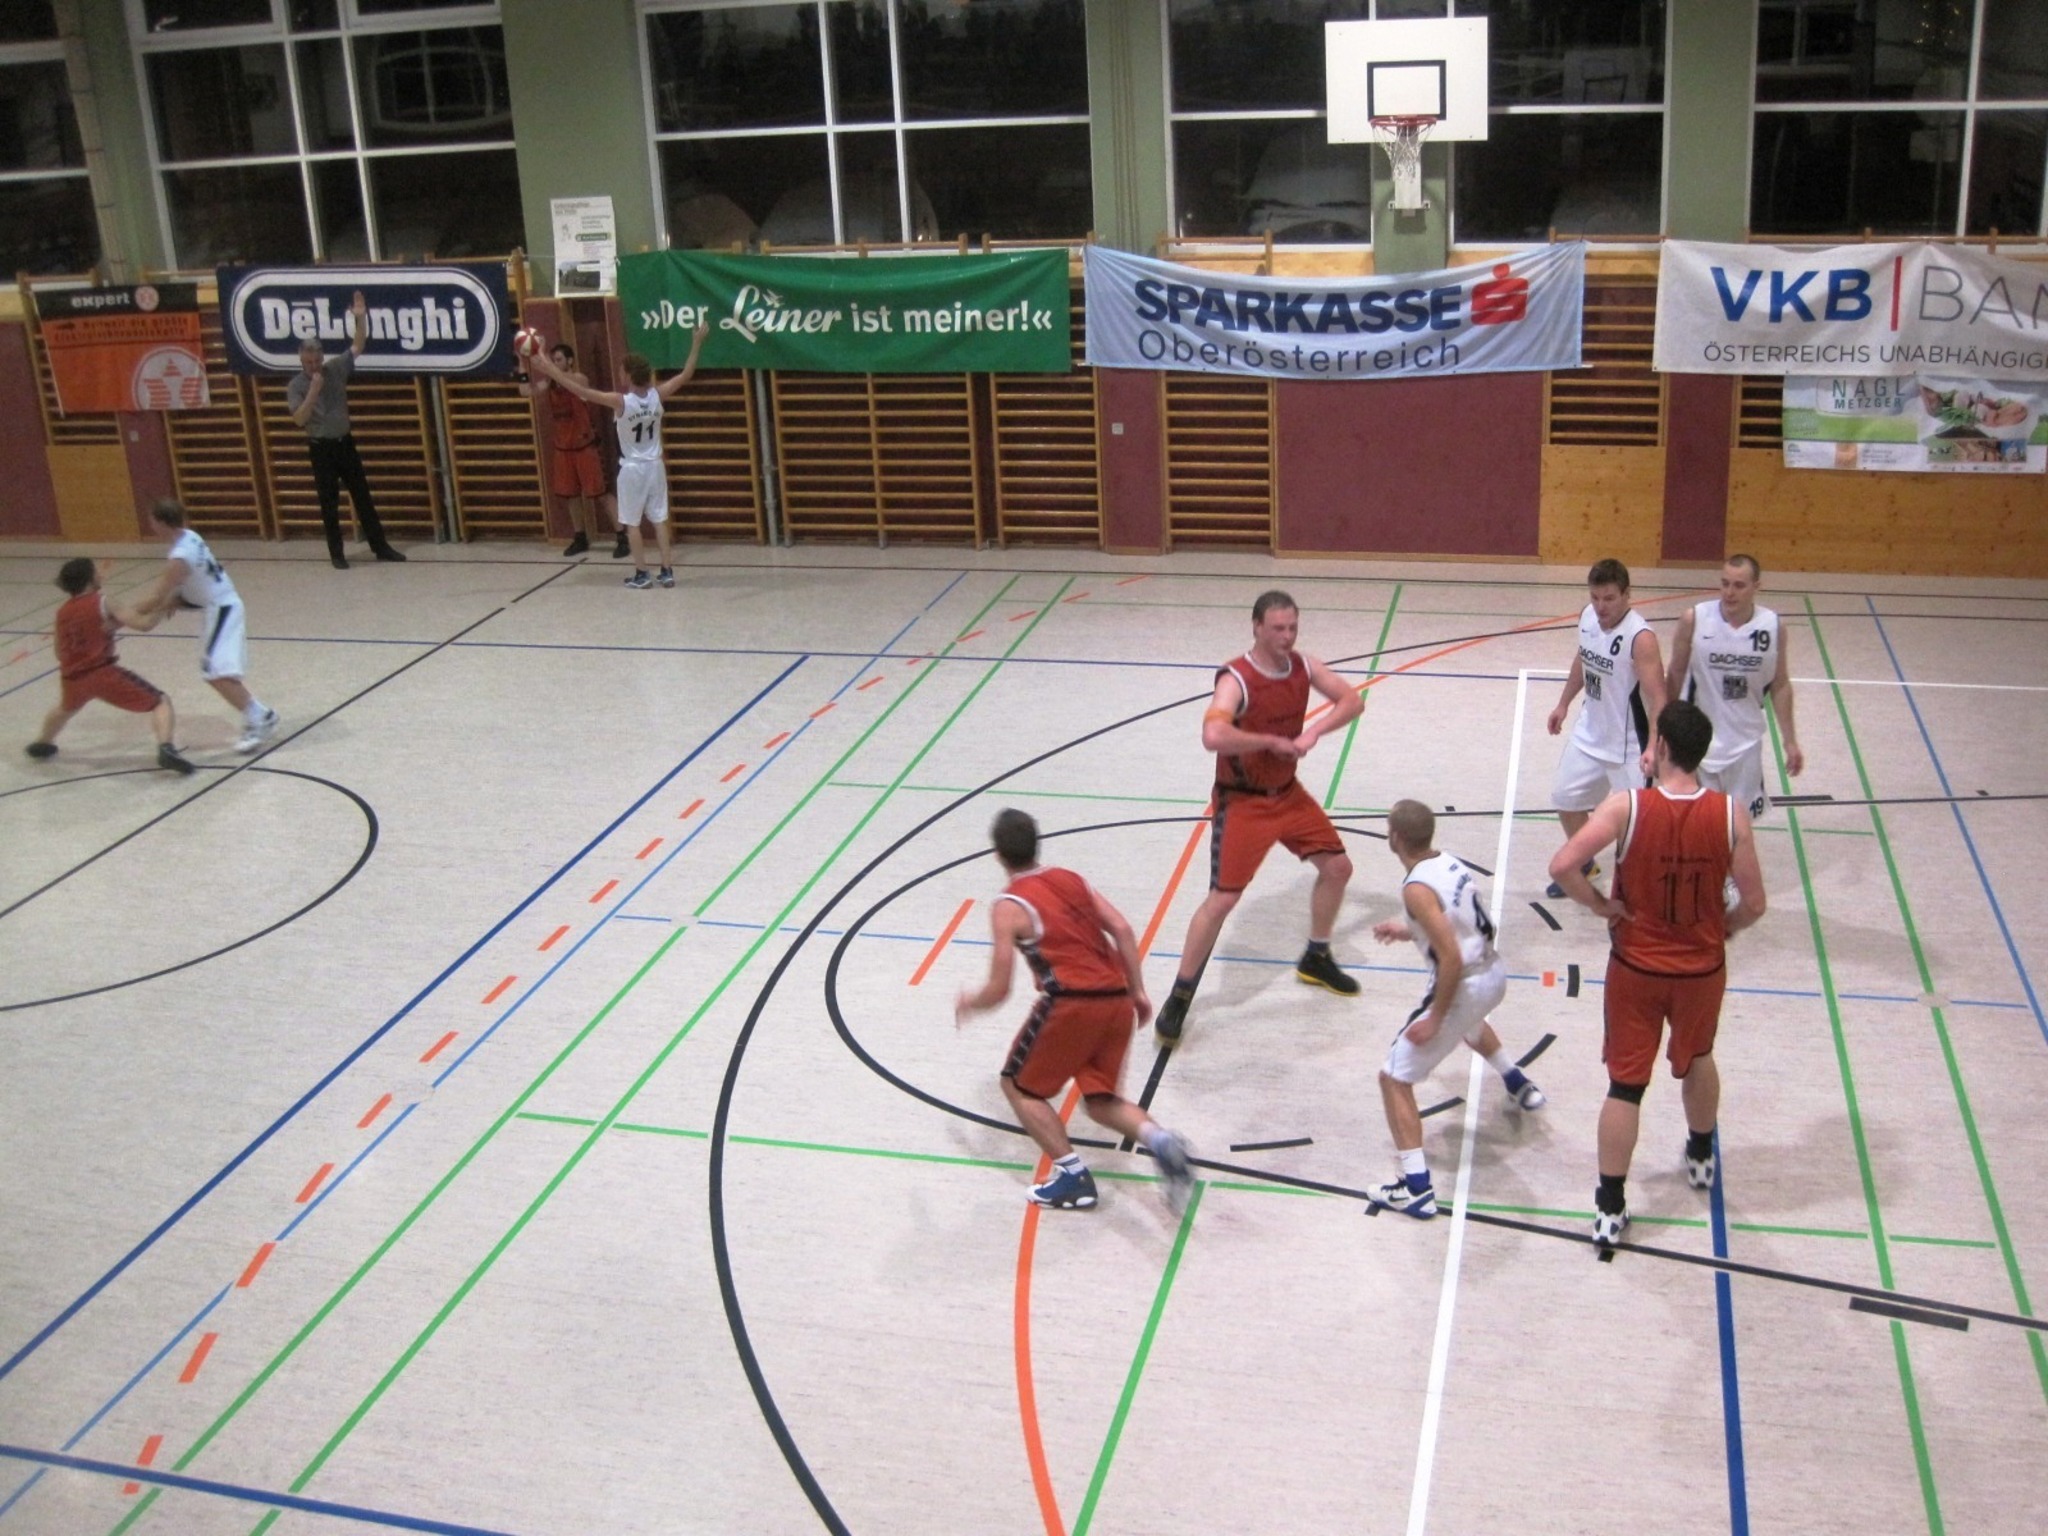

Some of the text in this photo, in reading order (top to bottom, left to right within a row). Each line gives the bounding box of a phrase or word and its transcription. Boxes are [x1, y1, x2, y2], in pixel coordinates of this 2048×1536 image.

[71, 292, 130, 308] expert
[1135, 279, 1462, 333] SPARKASSE
[1710, 267, 1873, 324] VKB
[719, 284, 843, 343] Leiner
[851, 302, 893, 333] ist
[903, 299, 1053, 333] meiner!«
[1137, 329, 1462, 373] Oberösterreich
[1703, 341, 2048, 370] ÖSTERREICHS UNABHÄNGIG
[1832, 377, 1906, 398] NAGL
[1834, 398, 1902, 410] METZGER
[631, 420, 656, 443] 11
[1609, 634, 1624, 656] 6
[1749, 629, 1771, 652] 19
[1708, 652, 1763, 667] DACHSER
[1750, 796, 1765, 818] 19
[1657, 871, 1705, 926] 11
